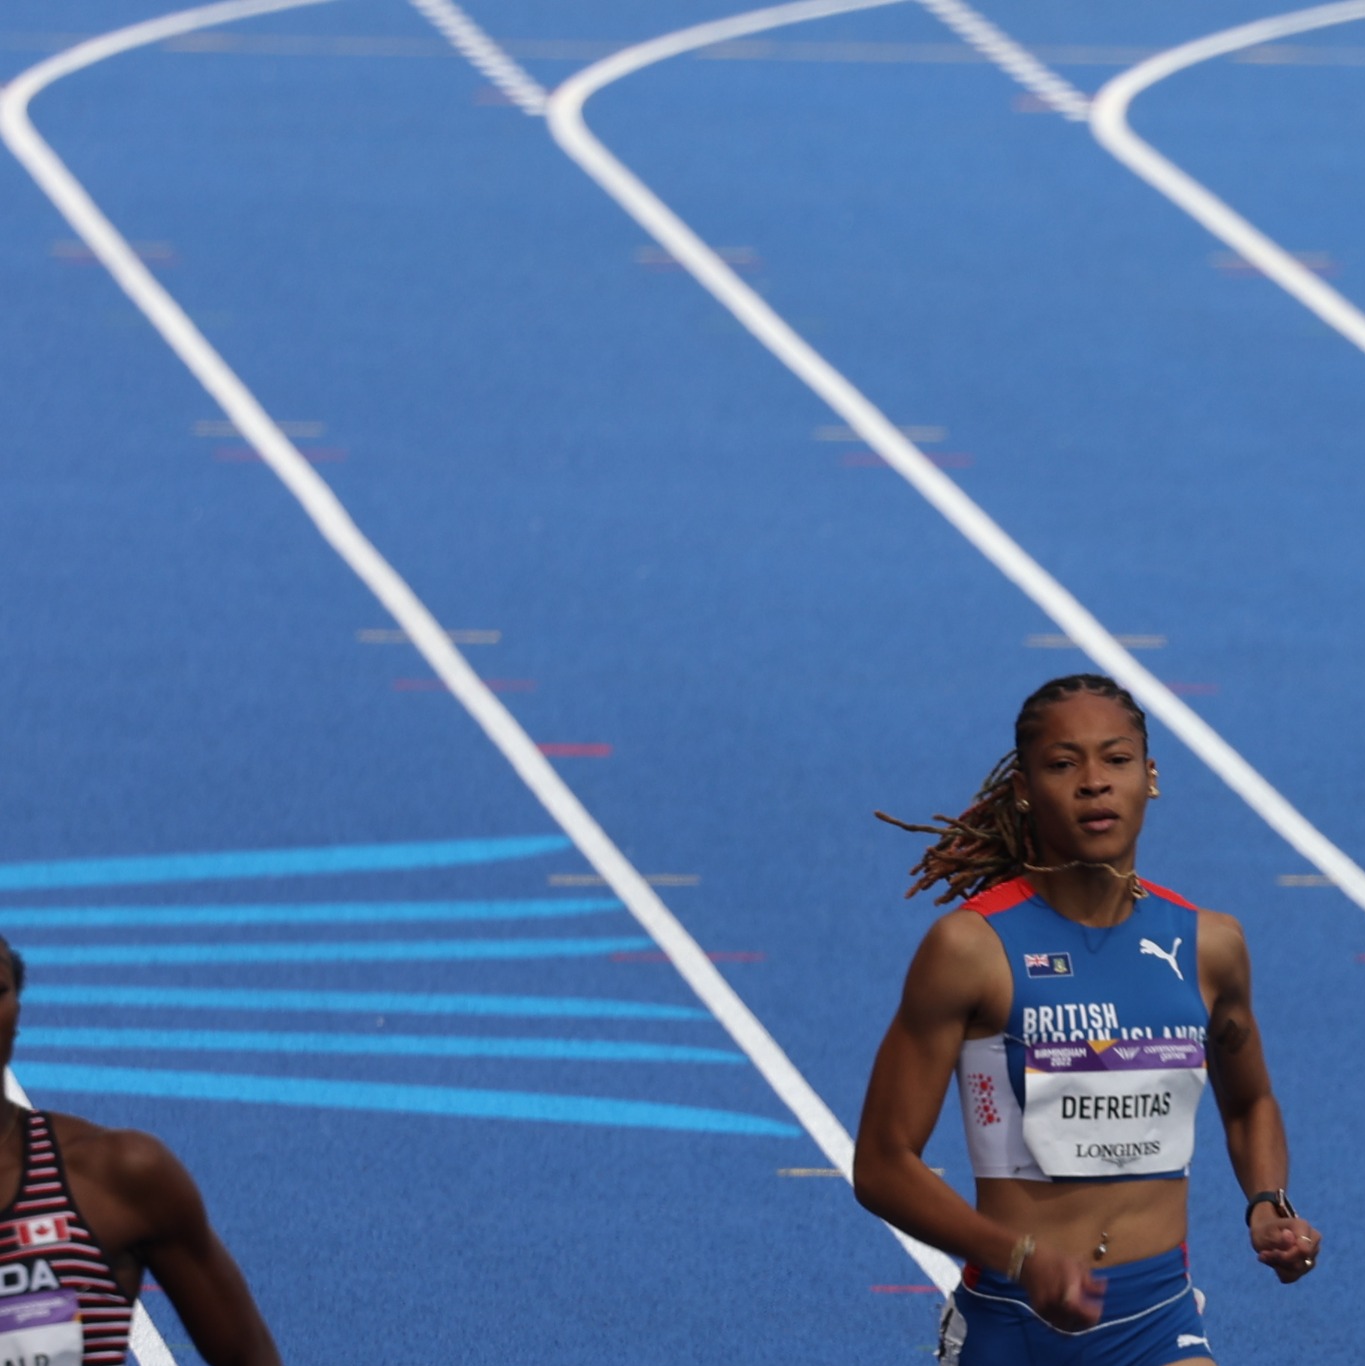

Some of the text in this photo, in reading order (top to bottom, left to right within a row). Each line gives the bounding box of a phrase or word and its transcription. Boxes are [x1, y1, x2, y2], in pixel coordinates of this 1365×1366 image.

[1022, 1003, 1119, 1034] BRITISH
[1061, 1091, 1171, 1120] DEFREITAS
[1075, 1141, 1161, 1159] LONGINES
